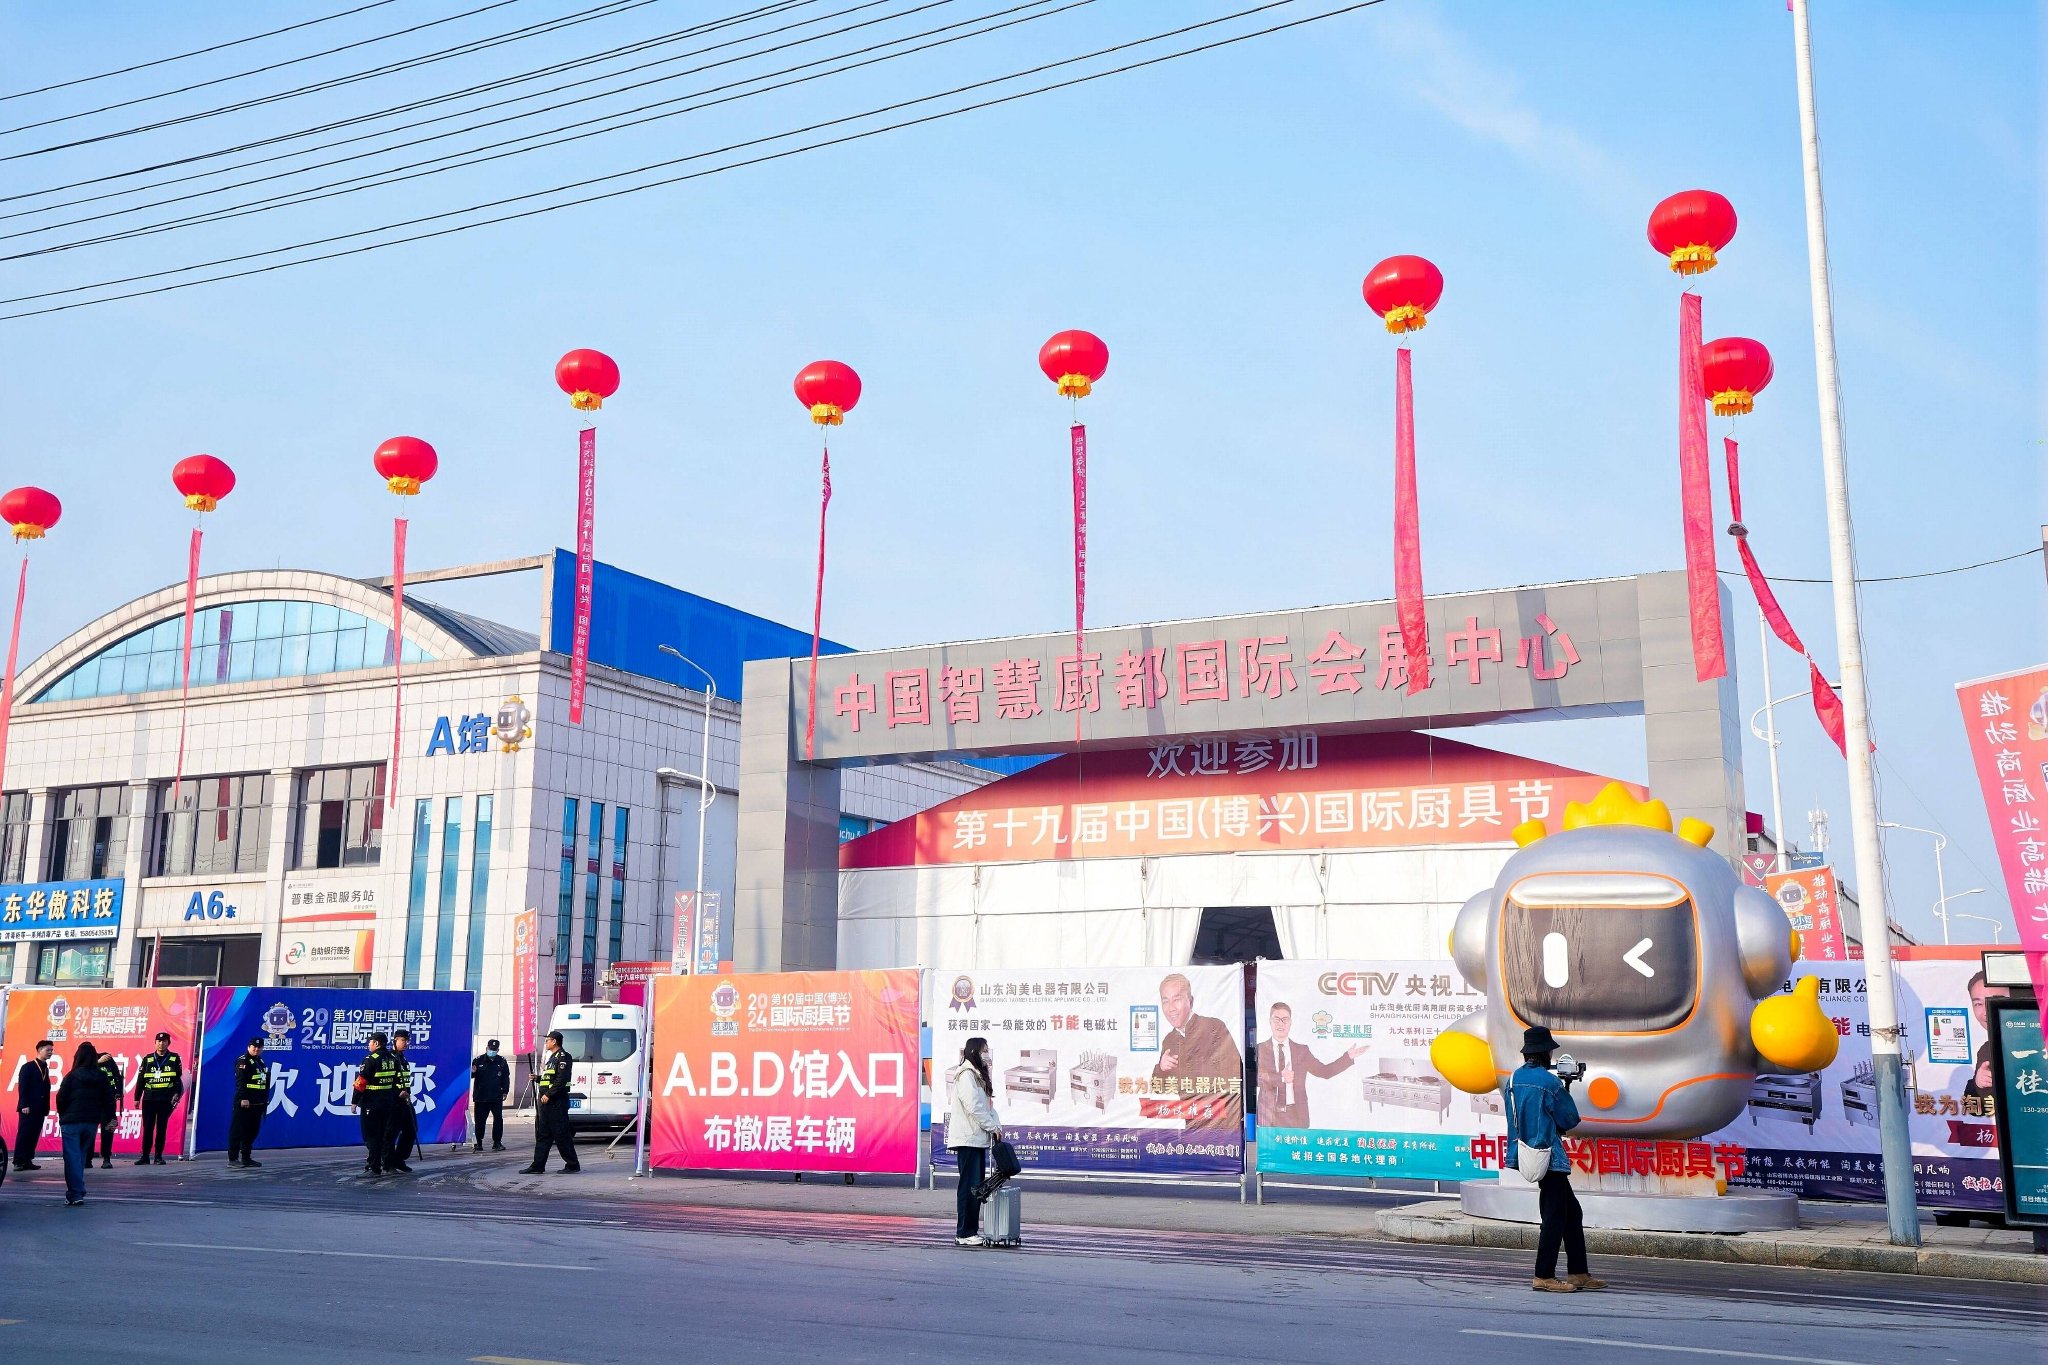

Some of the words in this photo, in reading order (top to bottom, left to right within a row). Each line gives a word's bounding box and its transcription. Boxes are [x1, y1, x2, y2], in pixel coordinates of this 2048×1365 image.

[834, 613, 1581, 732] 中国智慧厨都国际会展中心
[426, 713, 492, 756] A馆
[1147, 731, 1318, 778] 欢迎参加
[953, 780, 1553, 849] 第十九届中国(博兴)国际厨具节
[292, 890, 374, 905] 普惠金融服务站
[311, 946, 350, 955] 自助银行服务
[980, 982, 1109, 996] 山东淘美电器有限公司
[1318, 972, 1399, 996] CCTV
[771, 993, 851, 1005] 第19届中国(博兴)
[90, 1017, 148, 1034] 国际厨具节
[334, 1009, 432, 1023] 第19届中国(博兴)
[770, 1005, 851, 1027] 国际厨具节
[948, 1018, 1047, 1031] 获得国家一级能效的
[1050, 1015, 1080, 1031] 节能
[1083, 1018, 1118, 1031] 电磁灶
[1118, 1076, 1243, 1095] 我为淘美电器代言
[705, 1115, 856, 1154] 布撤展车辆
[1977, 1129, 1995, 1144] 杨
[1471, 1132, 1746, 1177] 中兴)国际厨具节
